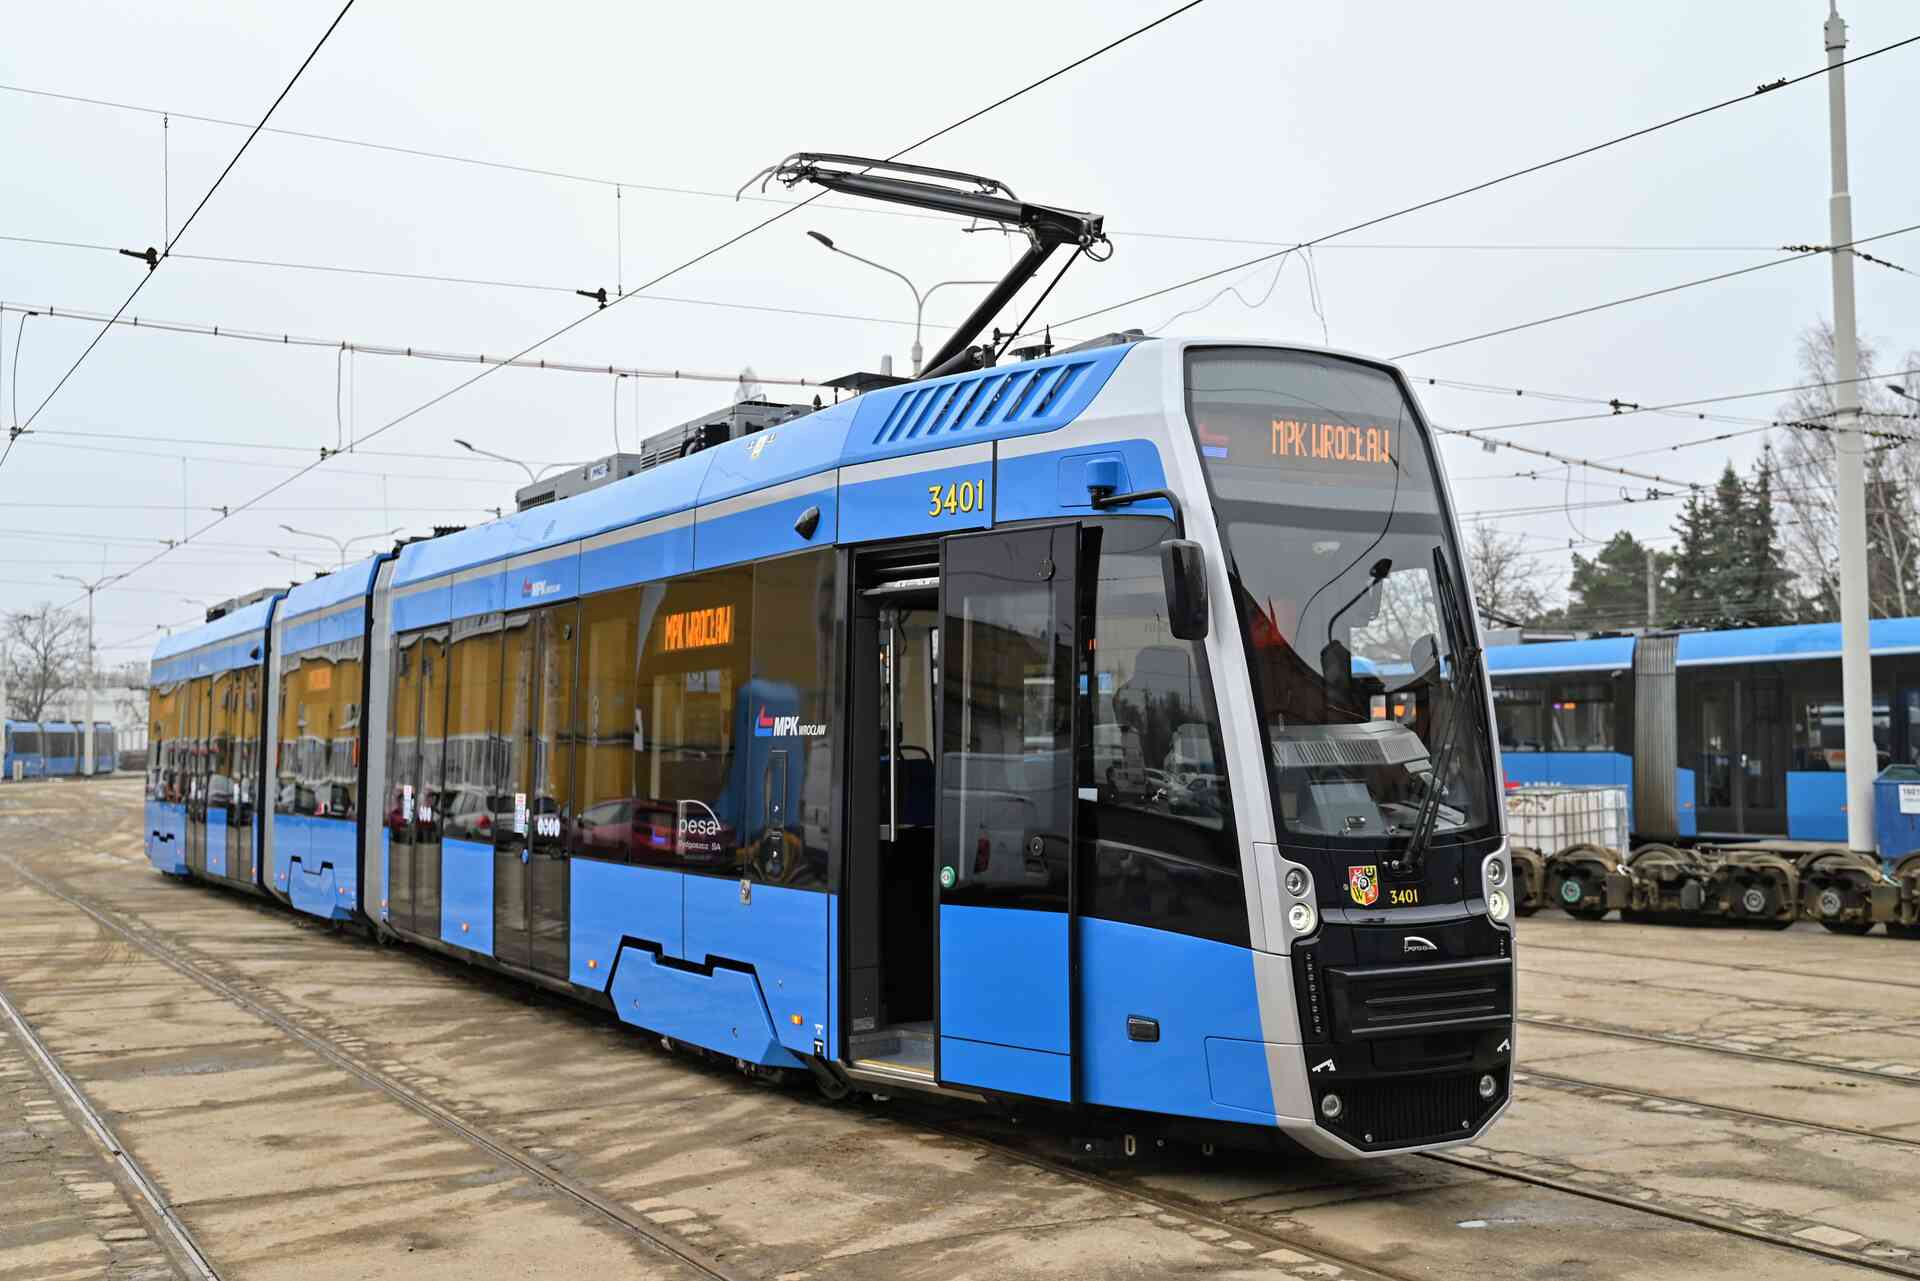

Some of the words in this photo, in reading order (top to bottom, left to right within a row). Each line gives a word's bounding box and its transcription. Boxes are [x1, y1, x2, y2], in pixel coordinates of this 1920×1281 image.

[1271, 420, 1307, 456] MPK
[1312, 423, 1389, 464] WROCŁAW
[928, 480, 984, 517] 3401
[664, 612, 684, 651] MPK
[773, 715, 799, 737] MPK
[679, 819, 717, 837] pesa
[1389, 888, 1418, 905] 3401
